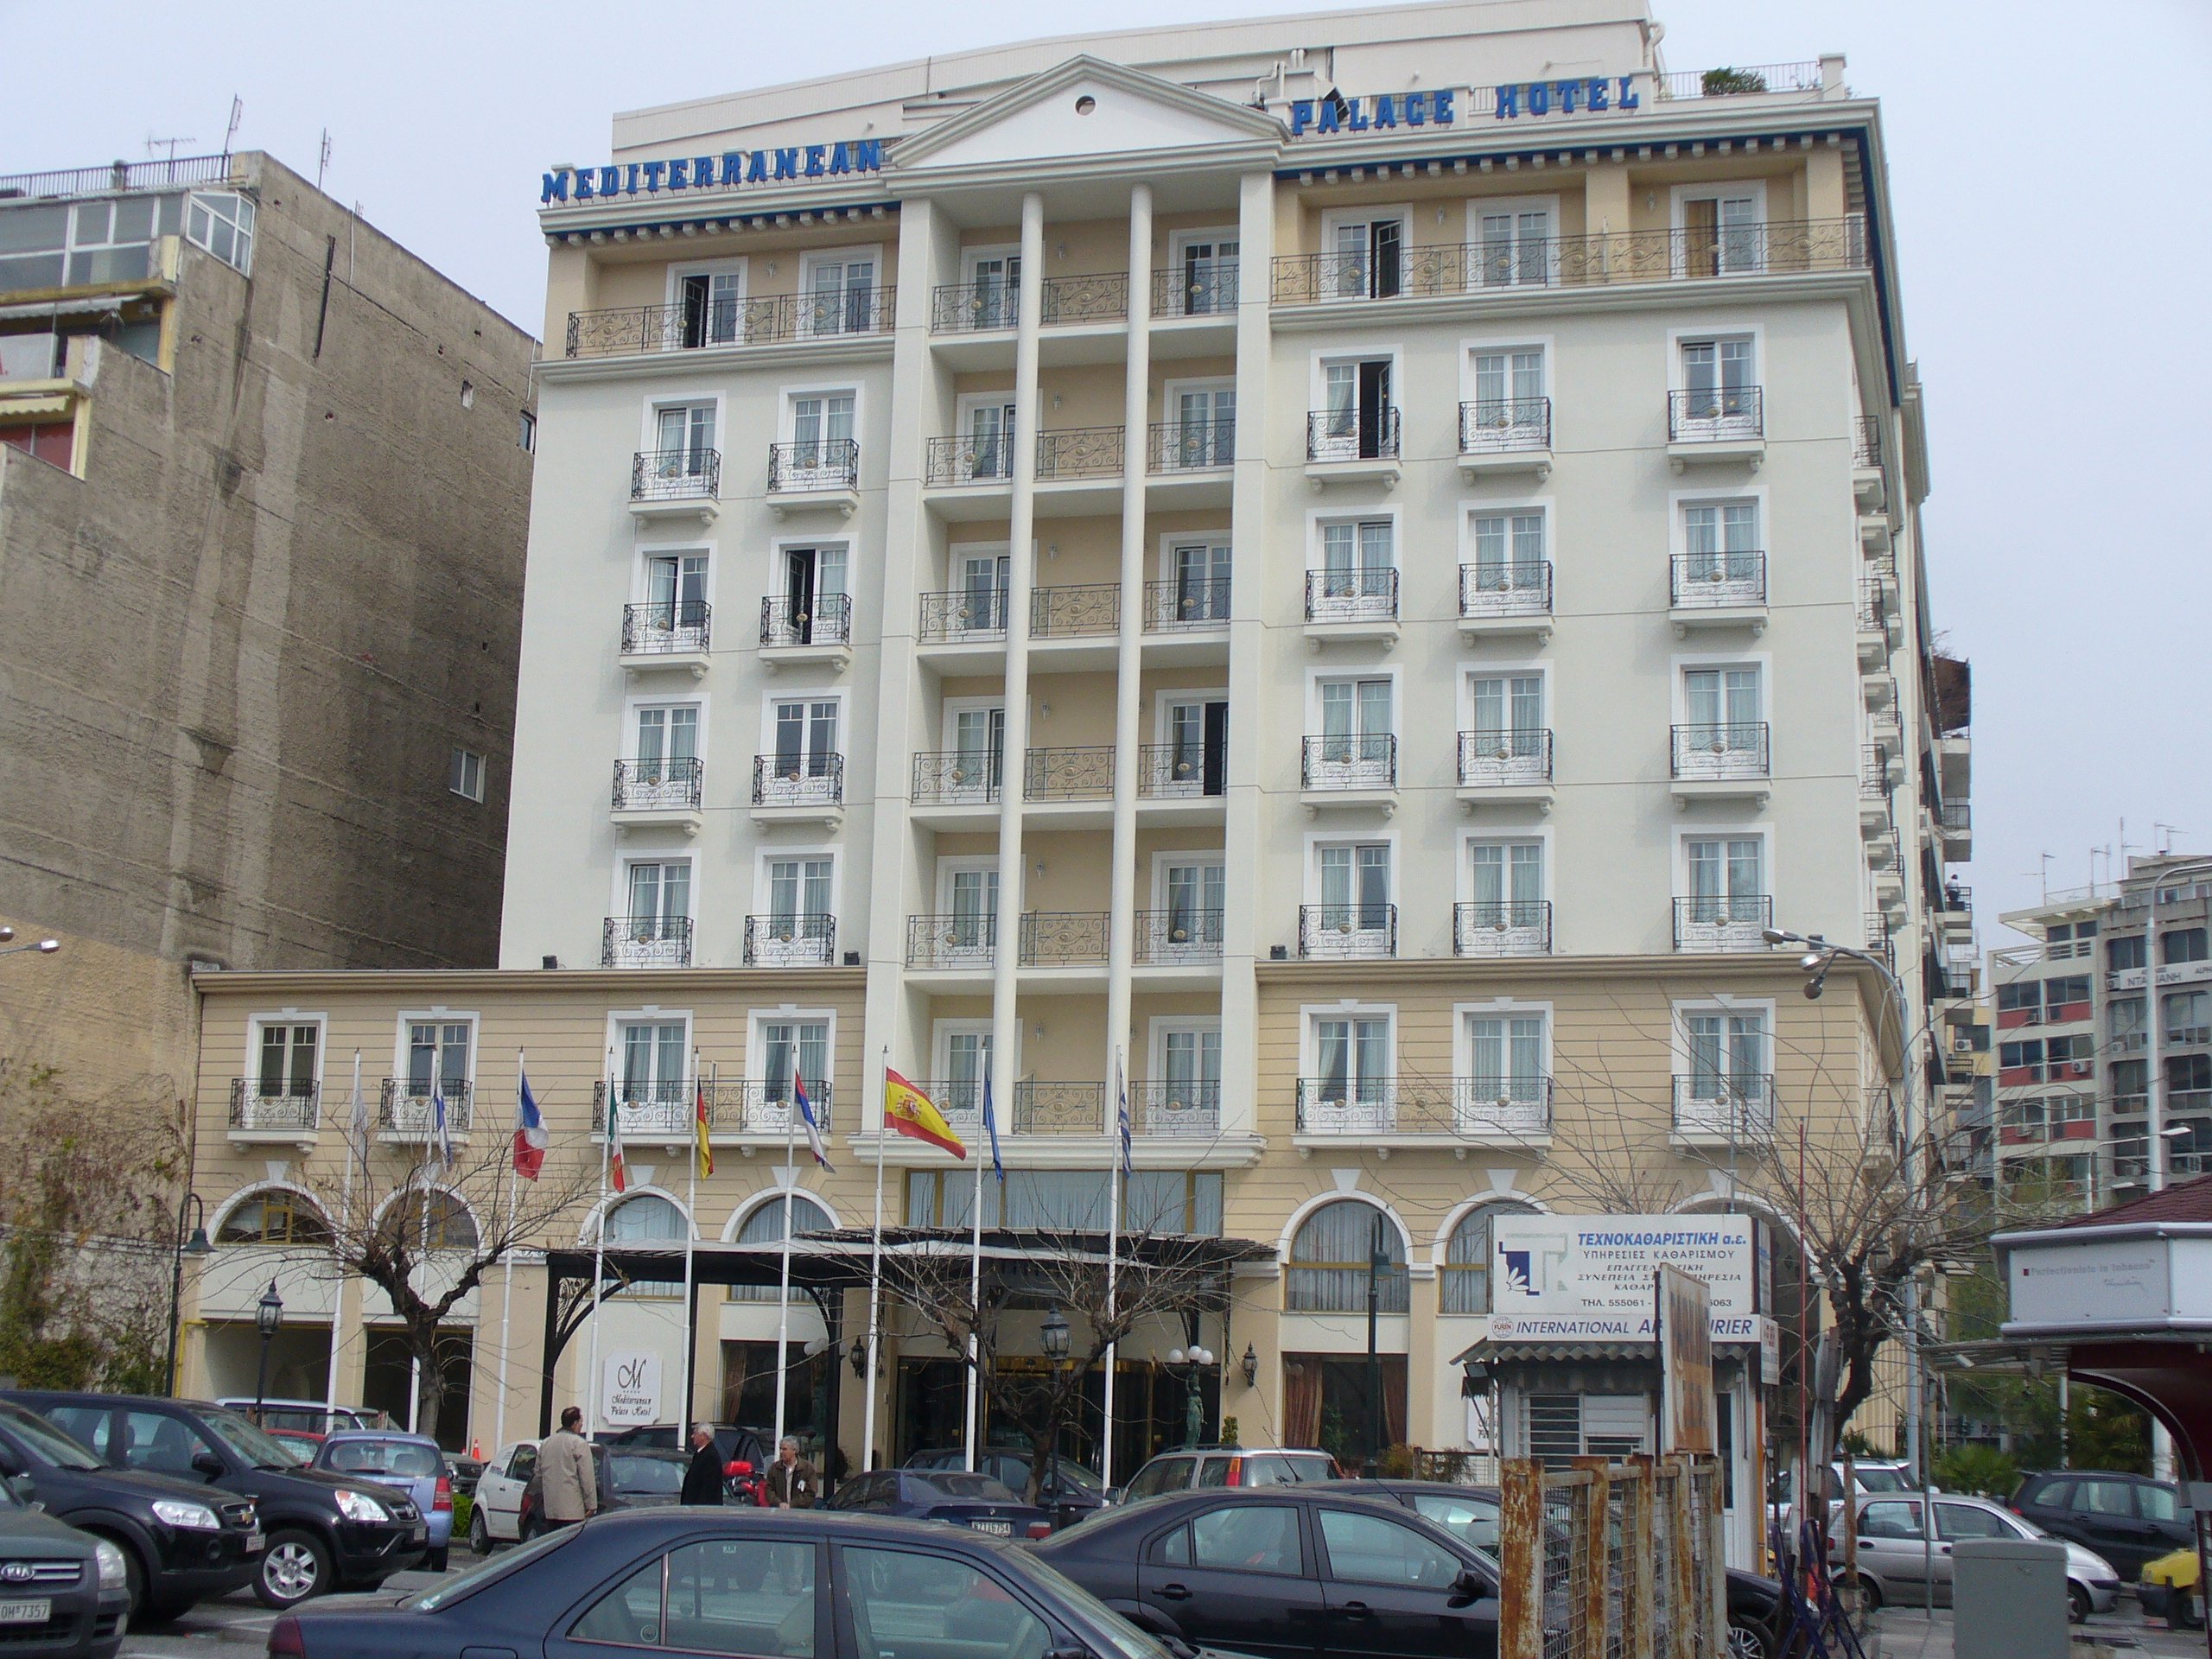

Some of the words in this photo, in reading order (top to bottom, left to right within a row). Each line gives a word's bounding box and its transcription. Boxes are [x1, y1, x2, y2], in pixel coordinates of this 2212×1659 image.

[541, 138, 881, 202] MEDITERRANEAN
[1292, 90, 1455, 136] PALACE
[1496, 76, 1640, 118] HOTEL
[1578, 1232, 1719, 1246] ΤΕΧΝΟΚΑΘΑΡΙΣΤΙΚΗ
[1583, 1250, 1645, 1260] ΥΠΗΡΕΣΙΕΣ
[1653, 1250, 1735, 1260] ΚΑΘΑΡΙΣΜΟΥ
[1516, 1321, 1630, 1334] INTERNATIONAL
[7, 1567, 29, 1578] KIA
